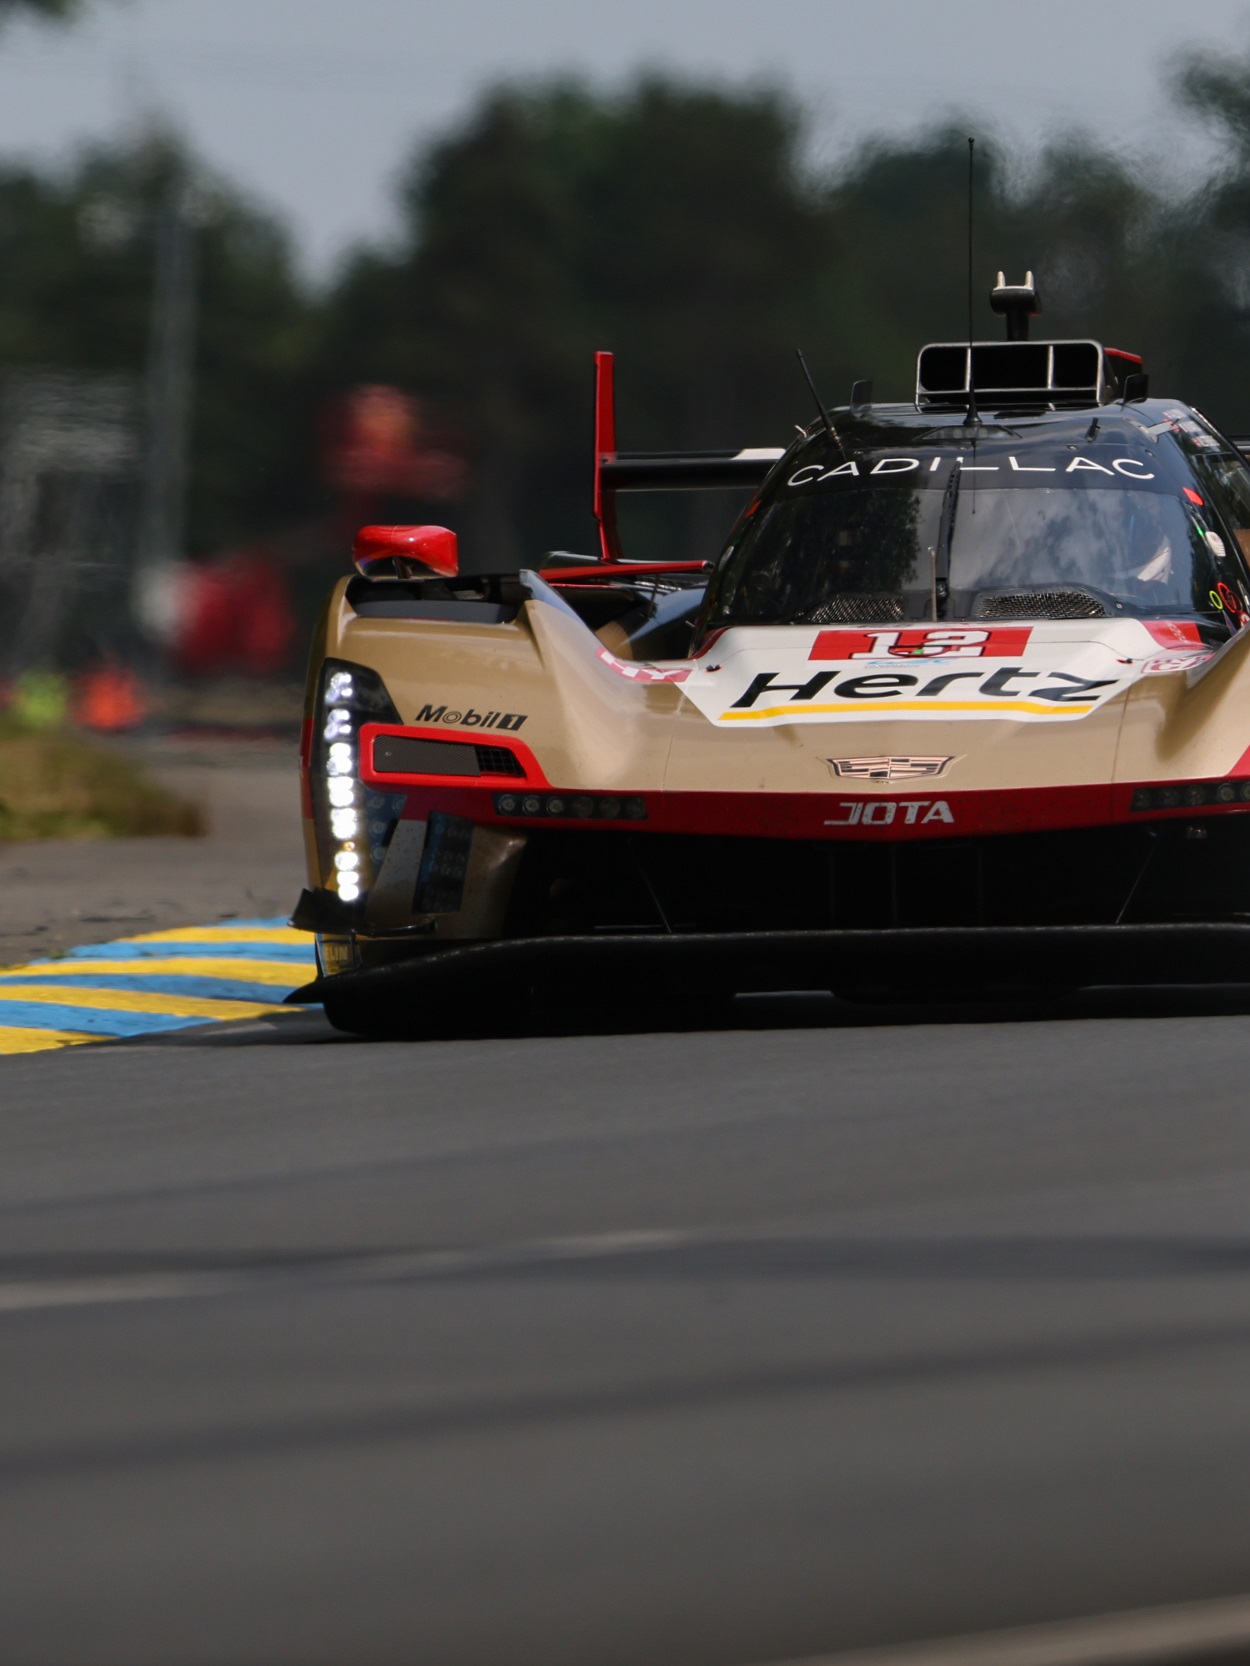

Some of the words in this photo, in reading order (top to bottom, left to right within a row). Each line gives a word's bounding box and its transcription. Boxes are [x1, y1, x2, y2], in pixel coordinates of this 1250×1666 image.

[787, 457, 1155, 486] CADILLAC
[850, 630, 991, 659] 12
[730, 667, 1119, 708] Hertz
[824, 800, 954, 825] JOTA
